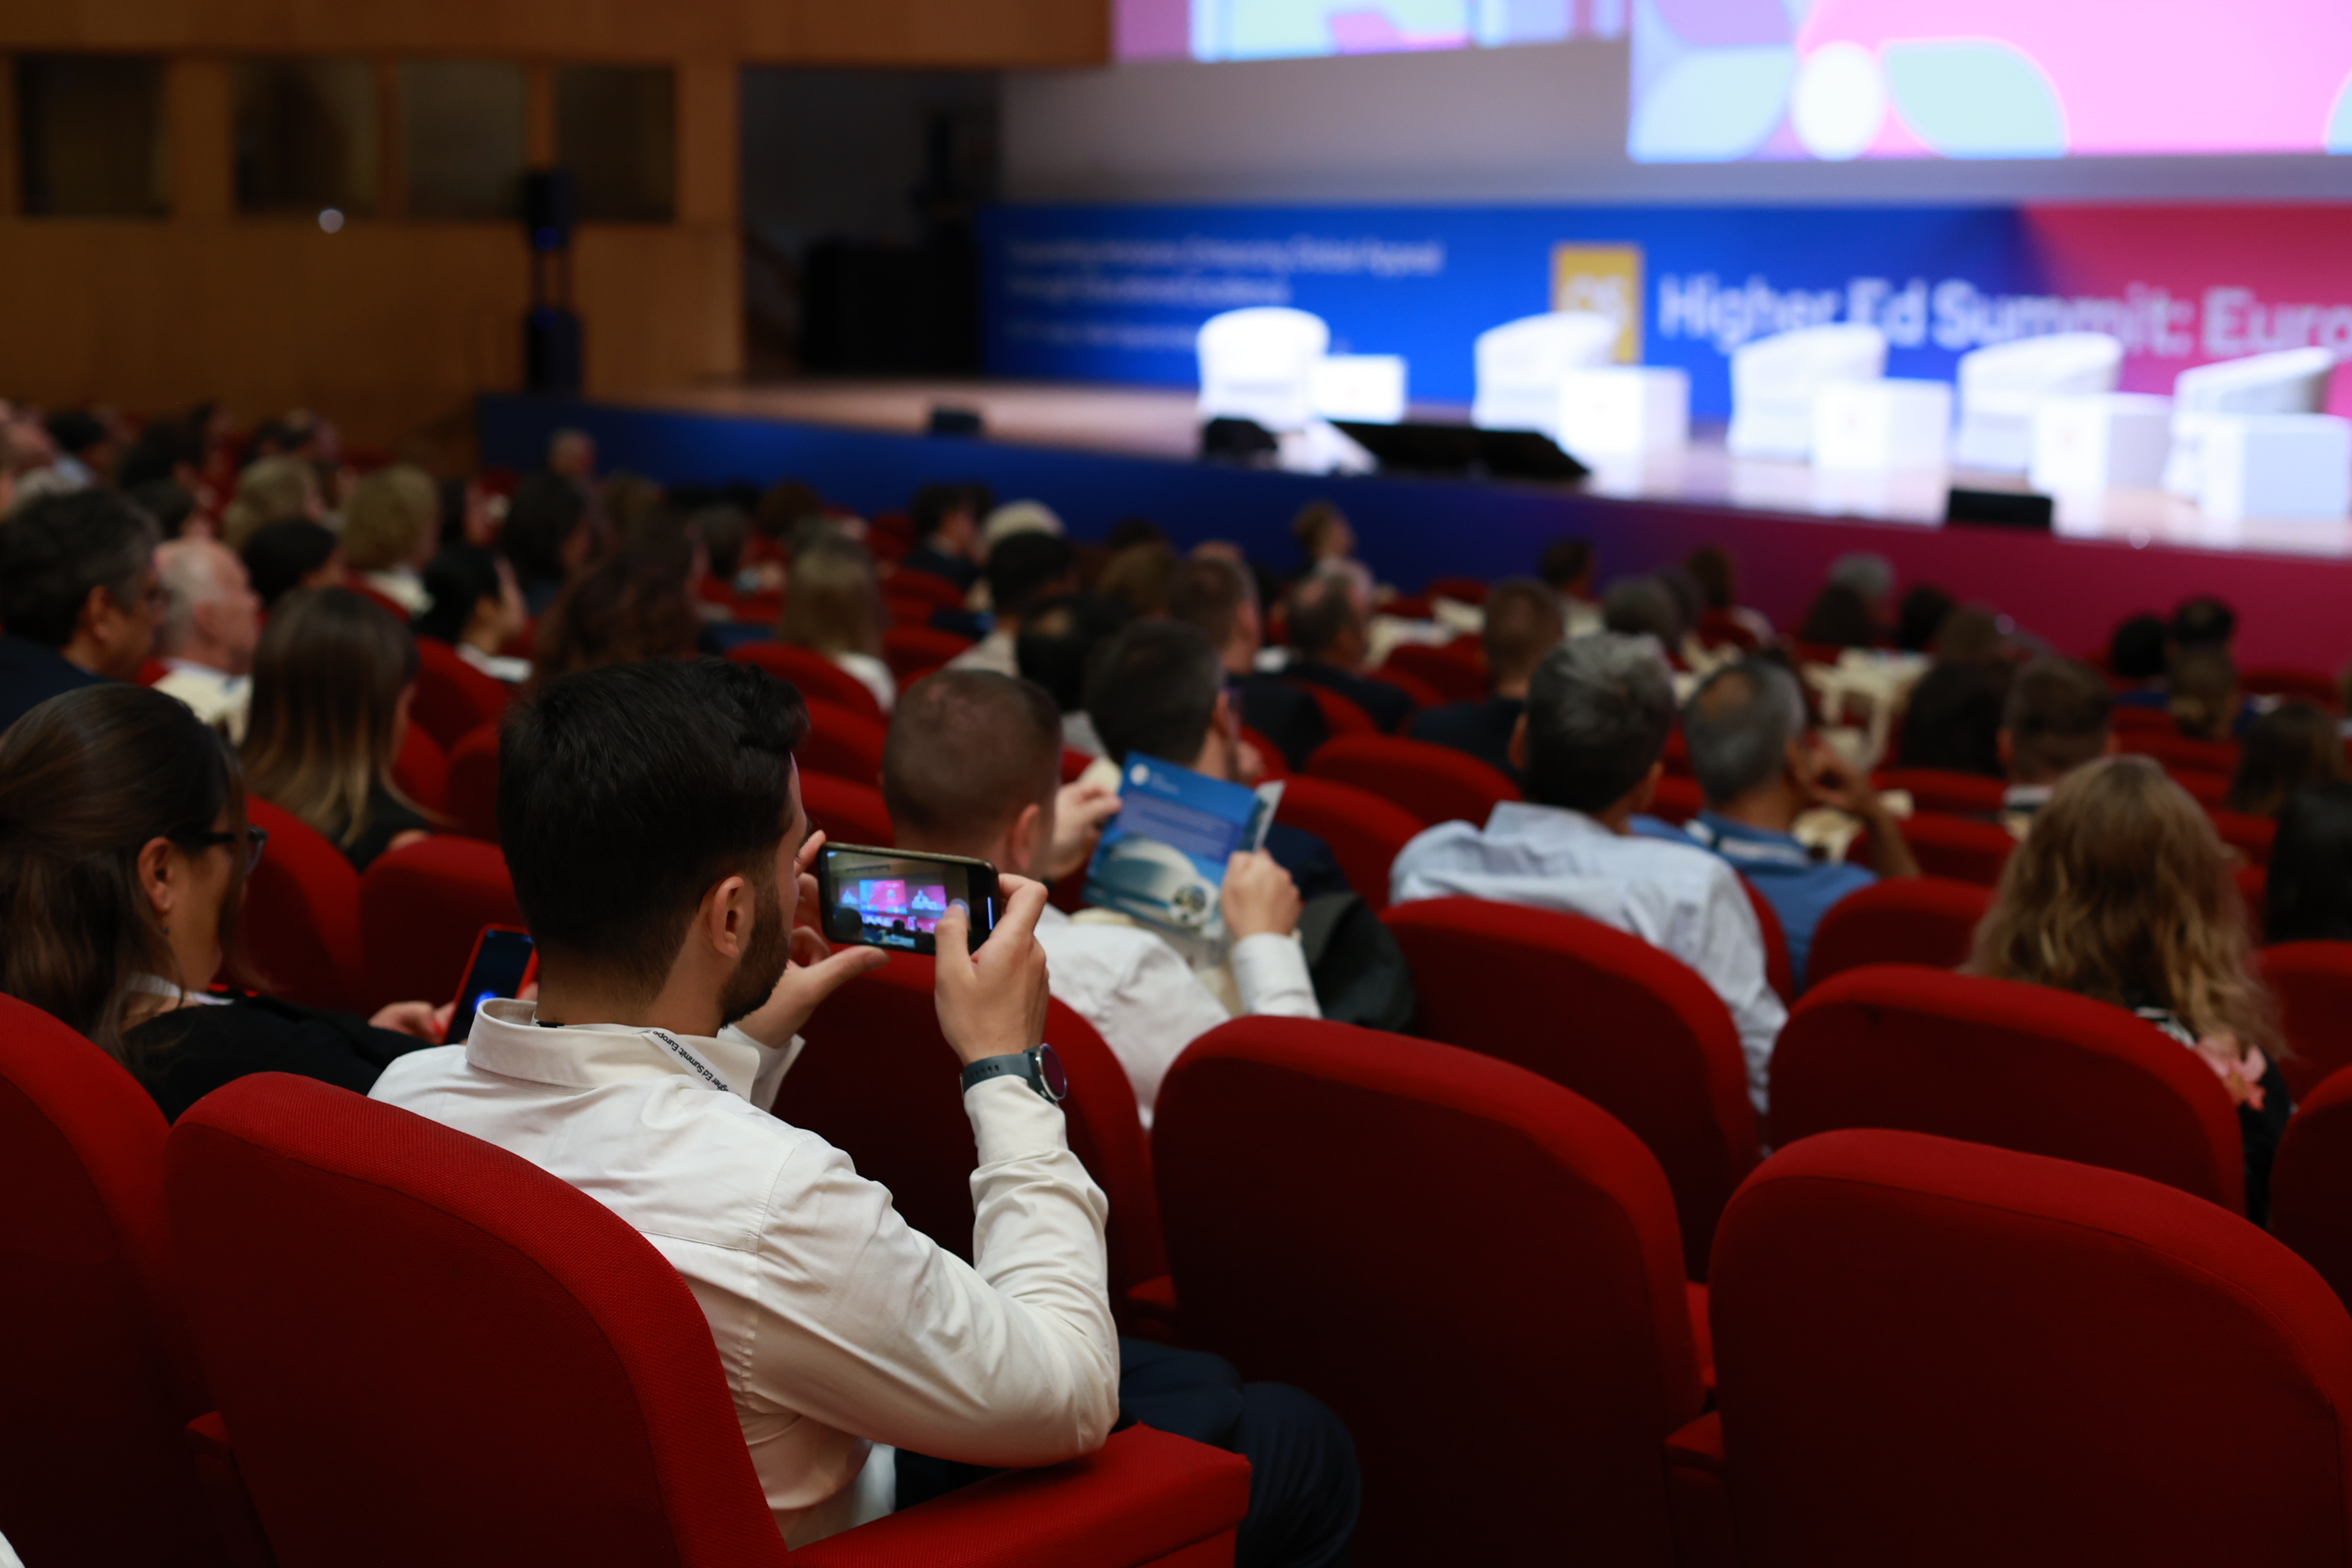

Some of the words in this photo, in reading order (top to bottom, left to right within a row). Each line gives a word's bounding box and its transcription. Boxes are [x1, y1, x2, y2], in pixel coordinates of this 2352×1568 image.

[1658, 273, 1843, 356] Higher
[1846, 277, 1928, 348] Ed
[653, 1031, 679, 1051] Europe
[702, 1069, 713, 1081] Ed
[711, 1077, 729, 1091] gher
